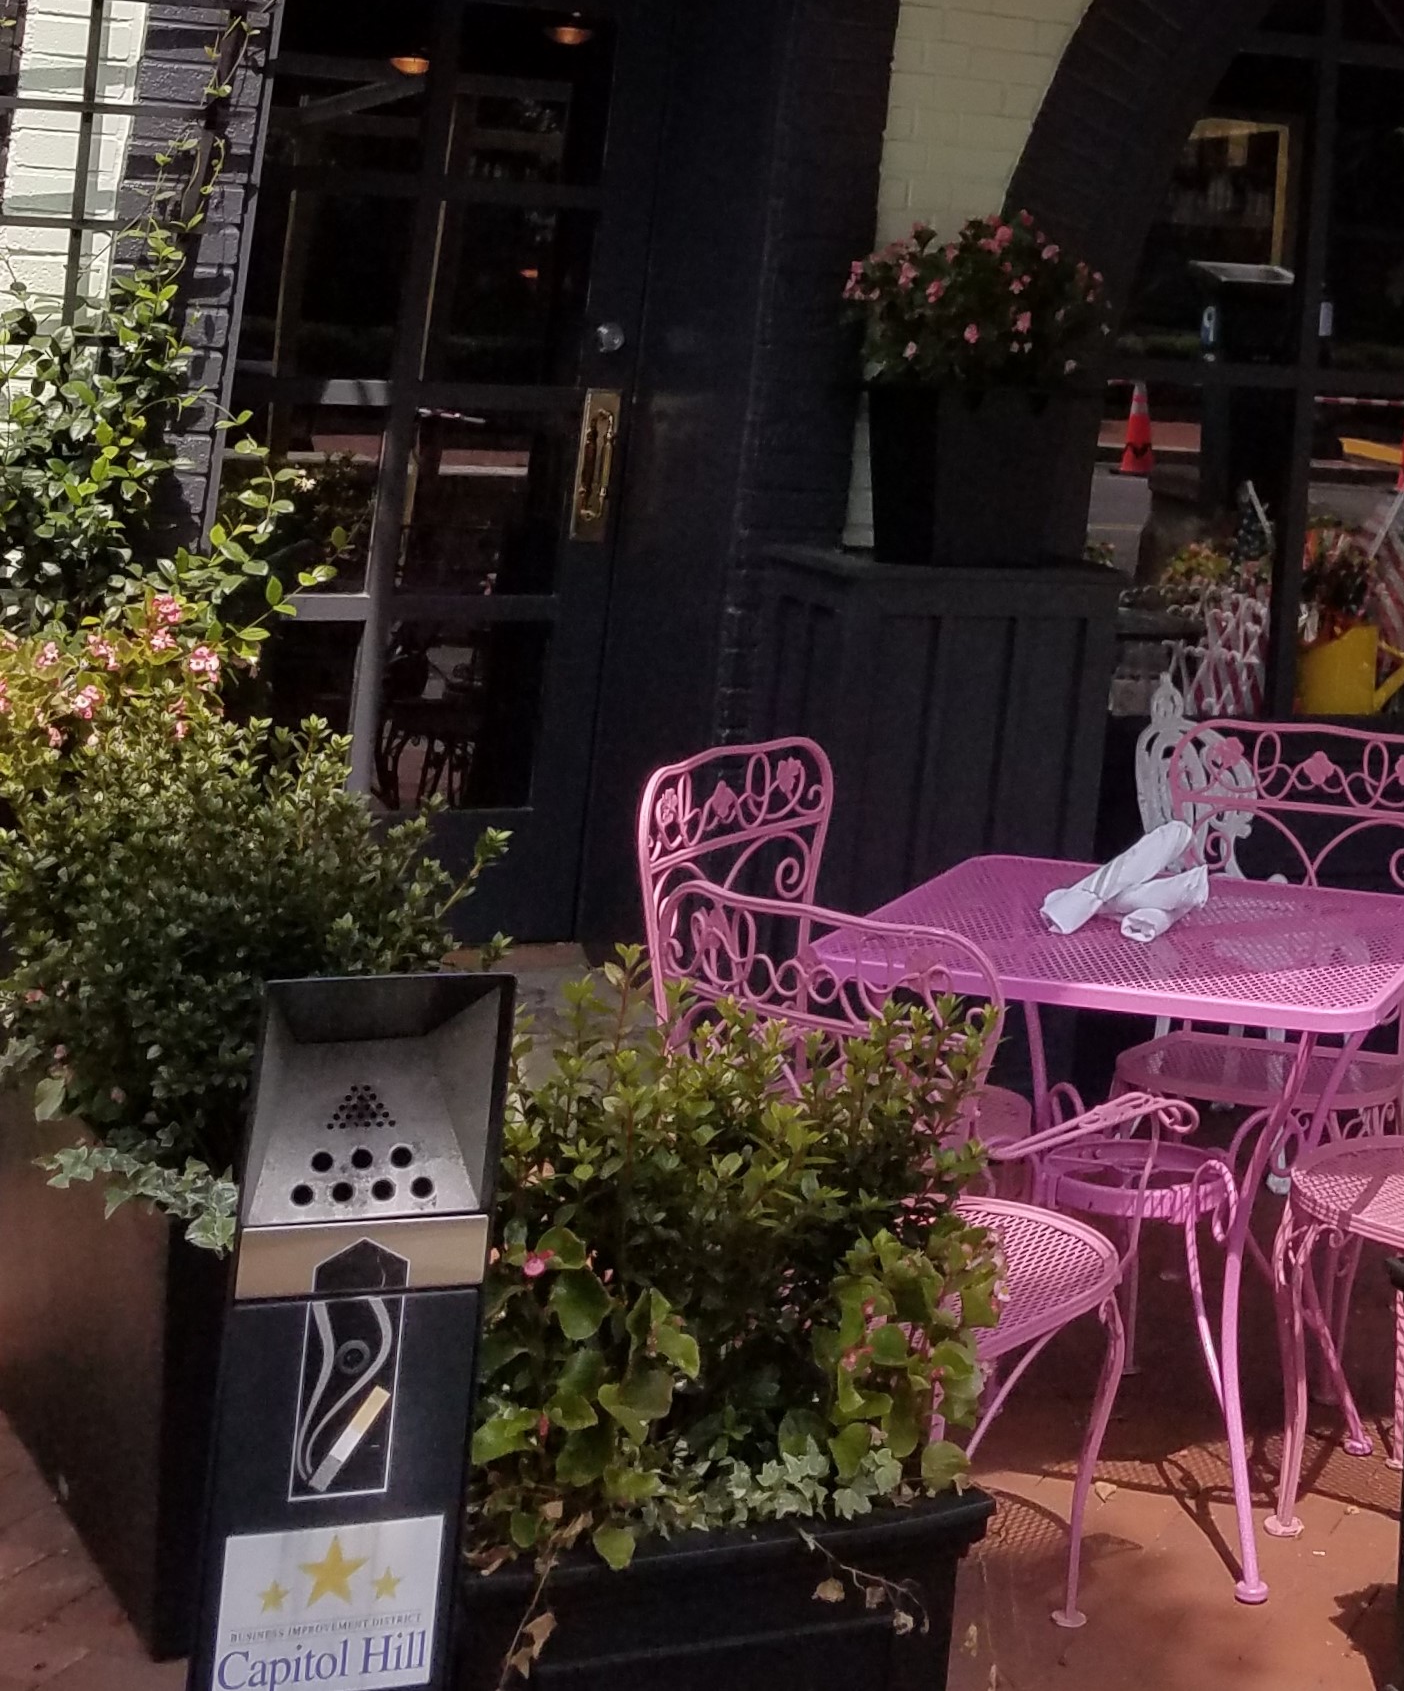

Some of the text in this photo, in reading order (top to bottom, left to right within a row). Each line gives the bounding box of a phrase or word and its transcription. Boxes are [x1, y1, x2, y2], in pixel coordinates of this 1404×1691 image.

[230, 1612, 422, 1642] BUSINESS IMPROVEMENT DISTRICT
[217, 1630, 427, 1691] Capitol Hill
